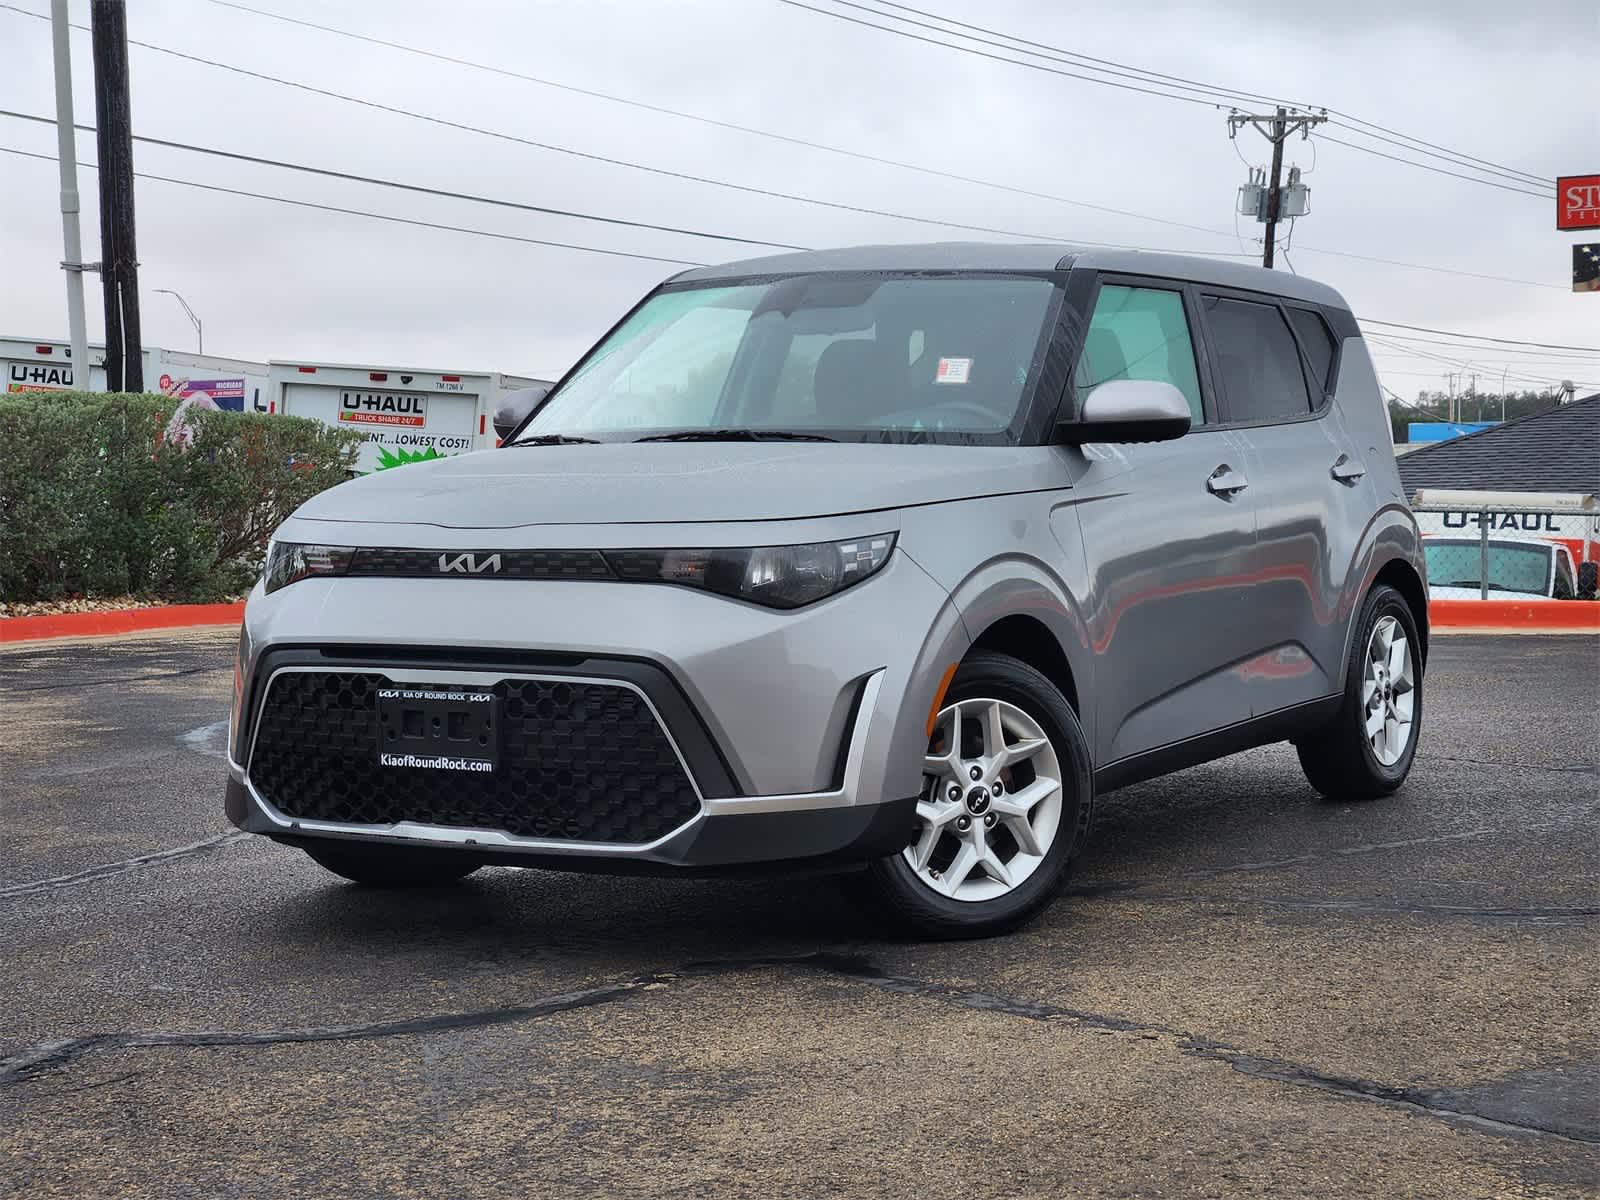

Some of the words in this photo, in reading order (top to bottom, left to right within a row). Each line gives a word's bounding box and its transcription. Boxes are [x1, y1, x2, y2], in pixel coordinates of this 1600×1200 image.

[11, 365, 74, 386] U-HAU
[343, 392, 424, 414] U-HAUL
[354, 413, 377, 422] TRUCK
[378, 415, 400, 424] SHARE
[401, 417, 415, 425] 24/7
[439, 437, 470, 449] COST!
[1443, 511, 1561, 531] U-HAUL
[438, 553, 502, 573] KIA
[379, 690, 399, 698] KIA
[424, 692, 447, 700] ROUND
[447, 693, 465, 701] ROCK
[380, 753, 493, 772] KiaofRoundRock.com
